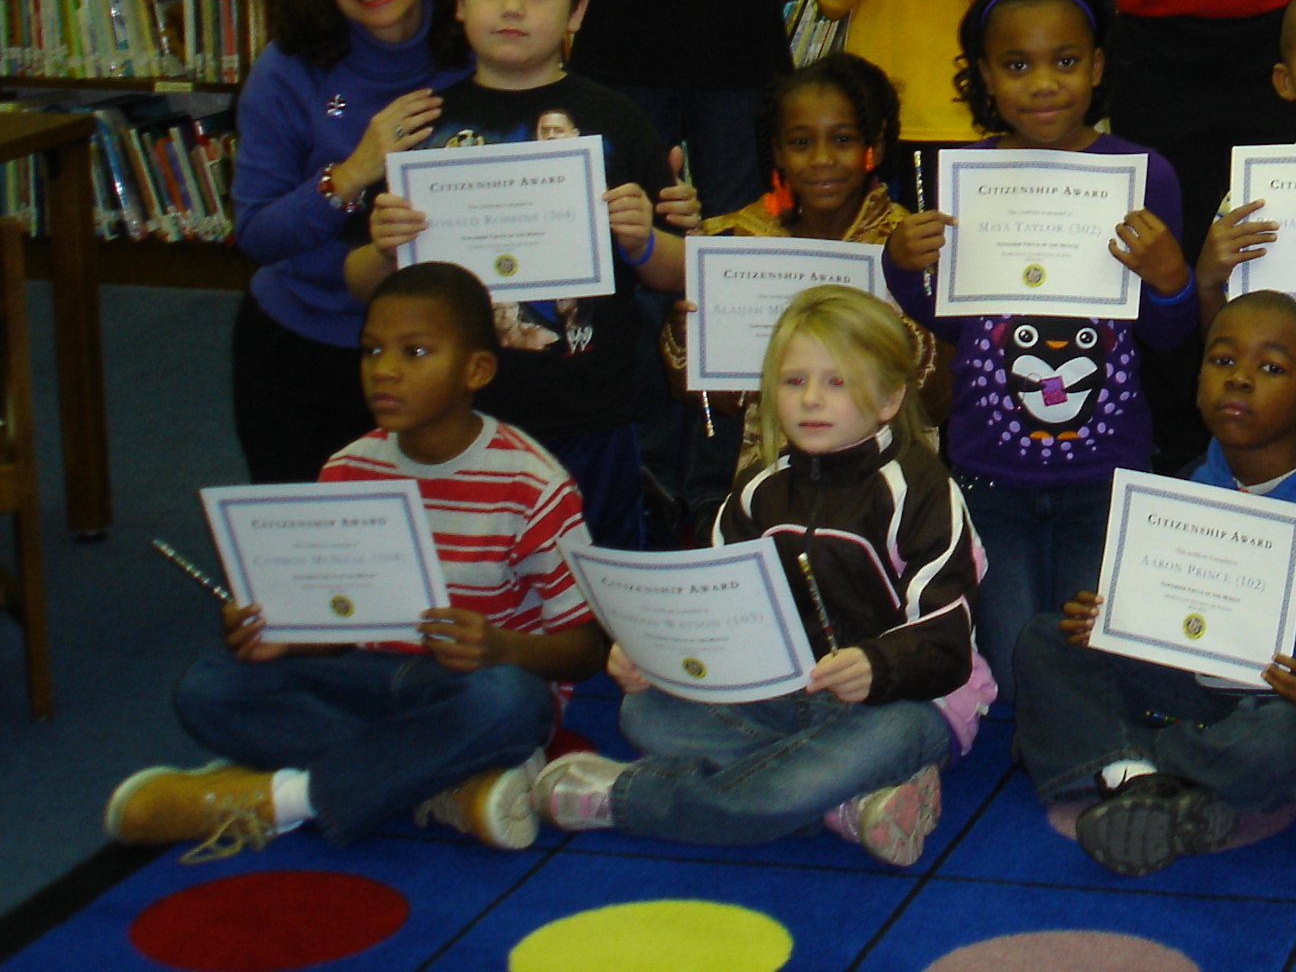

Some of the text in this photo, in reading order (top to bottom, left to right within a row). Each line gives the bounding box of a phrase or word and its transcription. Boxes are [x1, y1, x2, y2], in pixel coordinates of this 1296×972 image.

[429, 174, 566, 193] CITIZENSHIP AWARD
[978, 185, 1109, 199] CITIZENSHIP AWARD
[723, 269, 851, 284] CITIZENSHIP AWARD
[1147, 513, 1273, 550] CITIZENSHIP AWARD
